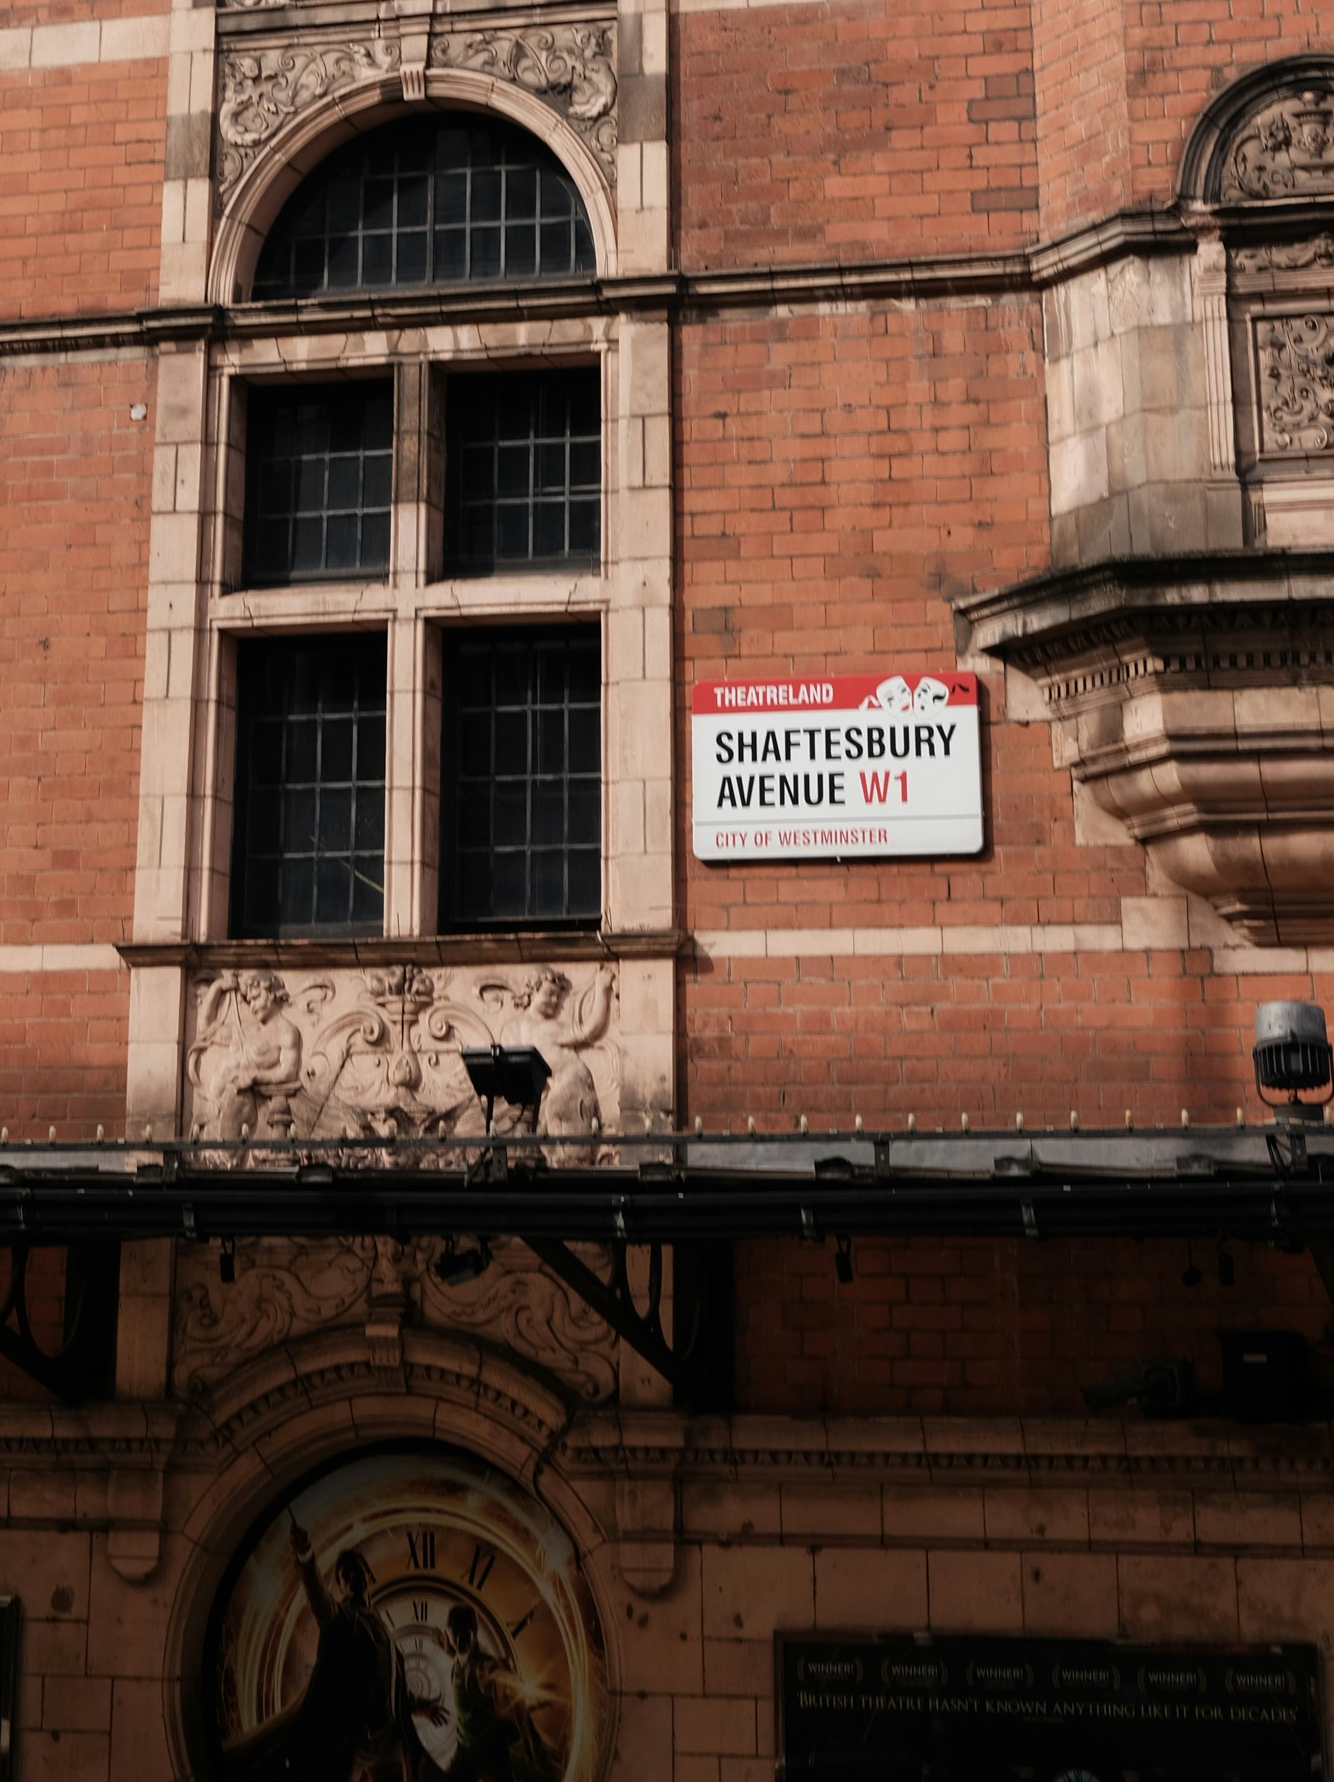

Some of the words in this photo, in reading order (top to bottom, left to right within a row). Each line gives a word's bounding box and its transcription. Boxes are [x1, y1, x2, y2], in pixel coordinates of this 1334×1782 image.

[714, 683, 834, 707] THEATRELAND
[716, 724, 956, 763] SHAFTESBURY
[717, 772, 846, 808] AVENUE
[859, 771, 908, 804] W1
[716, 831, 748, 849] CITY
[754, 830, 772, 847] OF
[779, 828, 888, 847] WESTMINSTER
[861, 1694, 923, 1712] THEATRE
[985, 1699, 1047, 1715] KNOWN
[1053, 1701, 1135, 1719] ANYTHING
[1140, 1703, 1170, 1720] LIKE
[1175, 1704, 1189, 1720] IT
